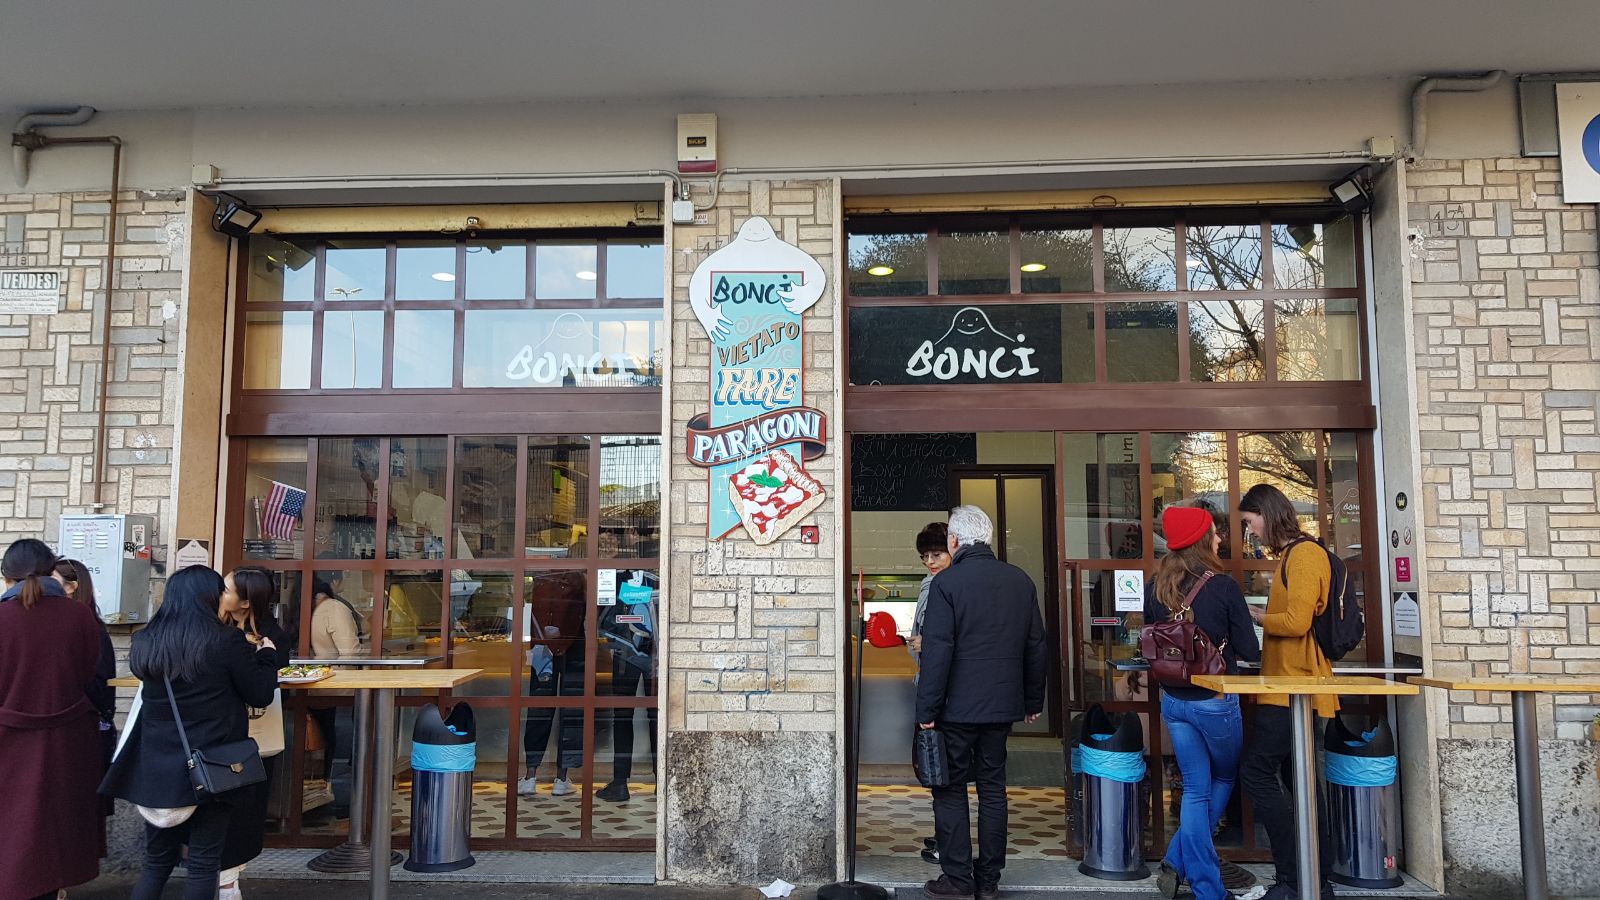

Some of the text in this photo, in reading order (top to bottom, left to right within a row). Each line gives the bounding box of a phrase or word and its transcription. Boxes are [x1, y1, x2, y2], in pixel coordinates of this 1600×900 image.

[3, 273, 57, 288] VENDESI
[717, 321, 800, 366] VIETATO
[714, 367, 801, 410] FARE
[692, 412, 822, 463] PARAGONI
